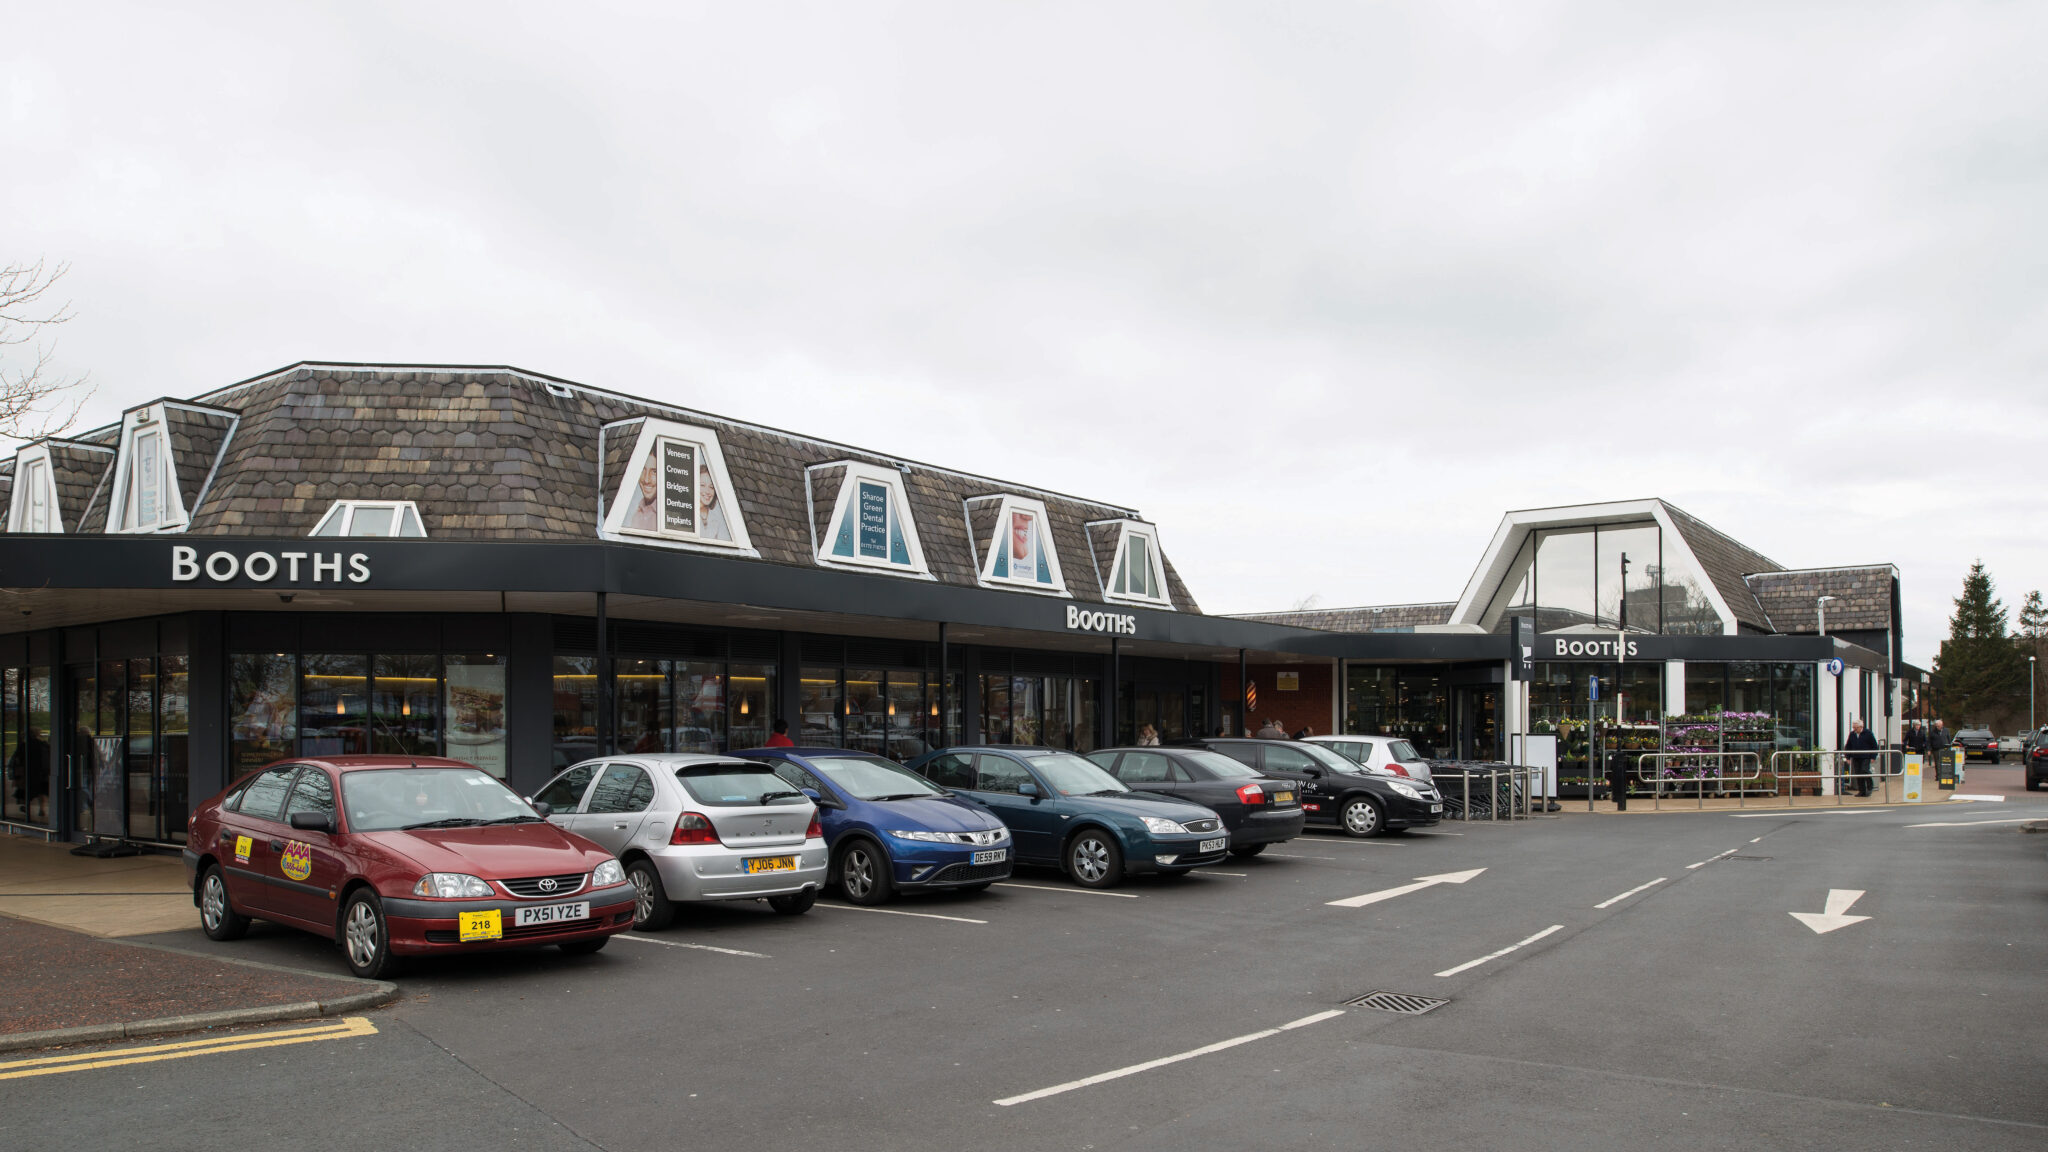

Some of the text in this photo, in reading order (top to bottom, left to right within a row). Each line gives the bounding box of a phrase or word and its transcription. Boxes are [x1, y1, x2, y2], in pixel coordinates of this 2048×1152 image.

[666, 447, 691, 460] Veneers
[666, 464, 689, 476] Crowns
[666, 481, 690, 493] Bridges
[862, 491, 884, 502] Sharoe
[666, 498, 693, 509] Dentures
[863, 502, 883, 512] Green
[666, 515, 692, 526] Implants
[863, 512, 884, 522] Dental
[861, 522, 886, 534] Practice
[172, 545, 371, 583] BOOTHS
[1066, 605, 1136, 634] BOOTHS
[1555, 638, 1638, 656] BOOTHS
[284, 841, 311, 862] AAA
[748, 856, 795, 871] YJ06 JNN
[557, 904, 582, 919] YZE
[471, 920, 491, 930] 218
